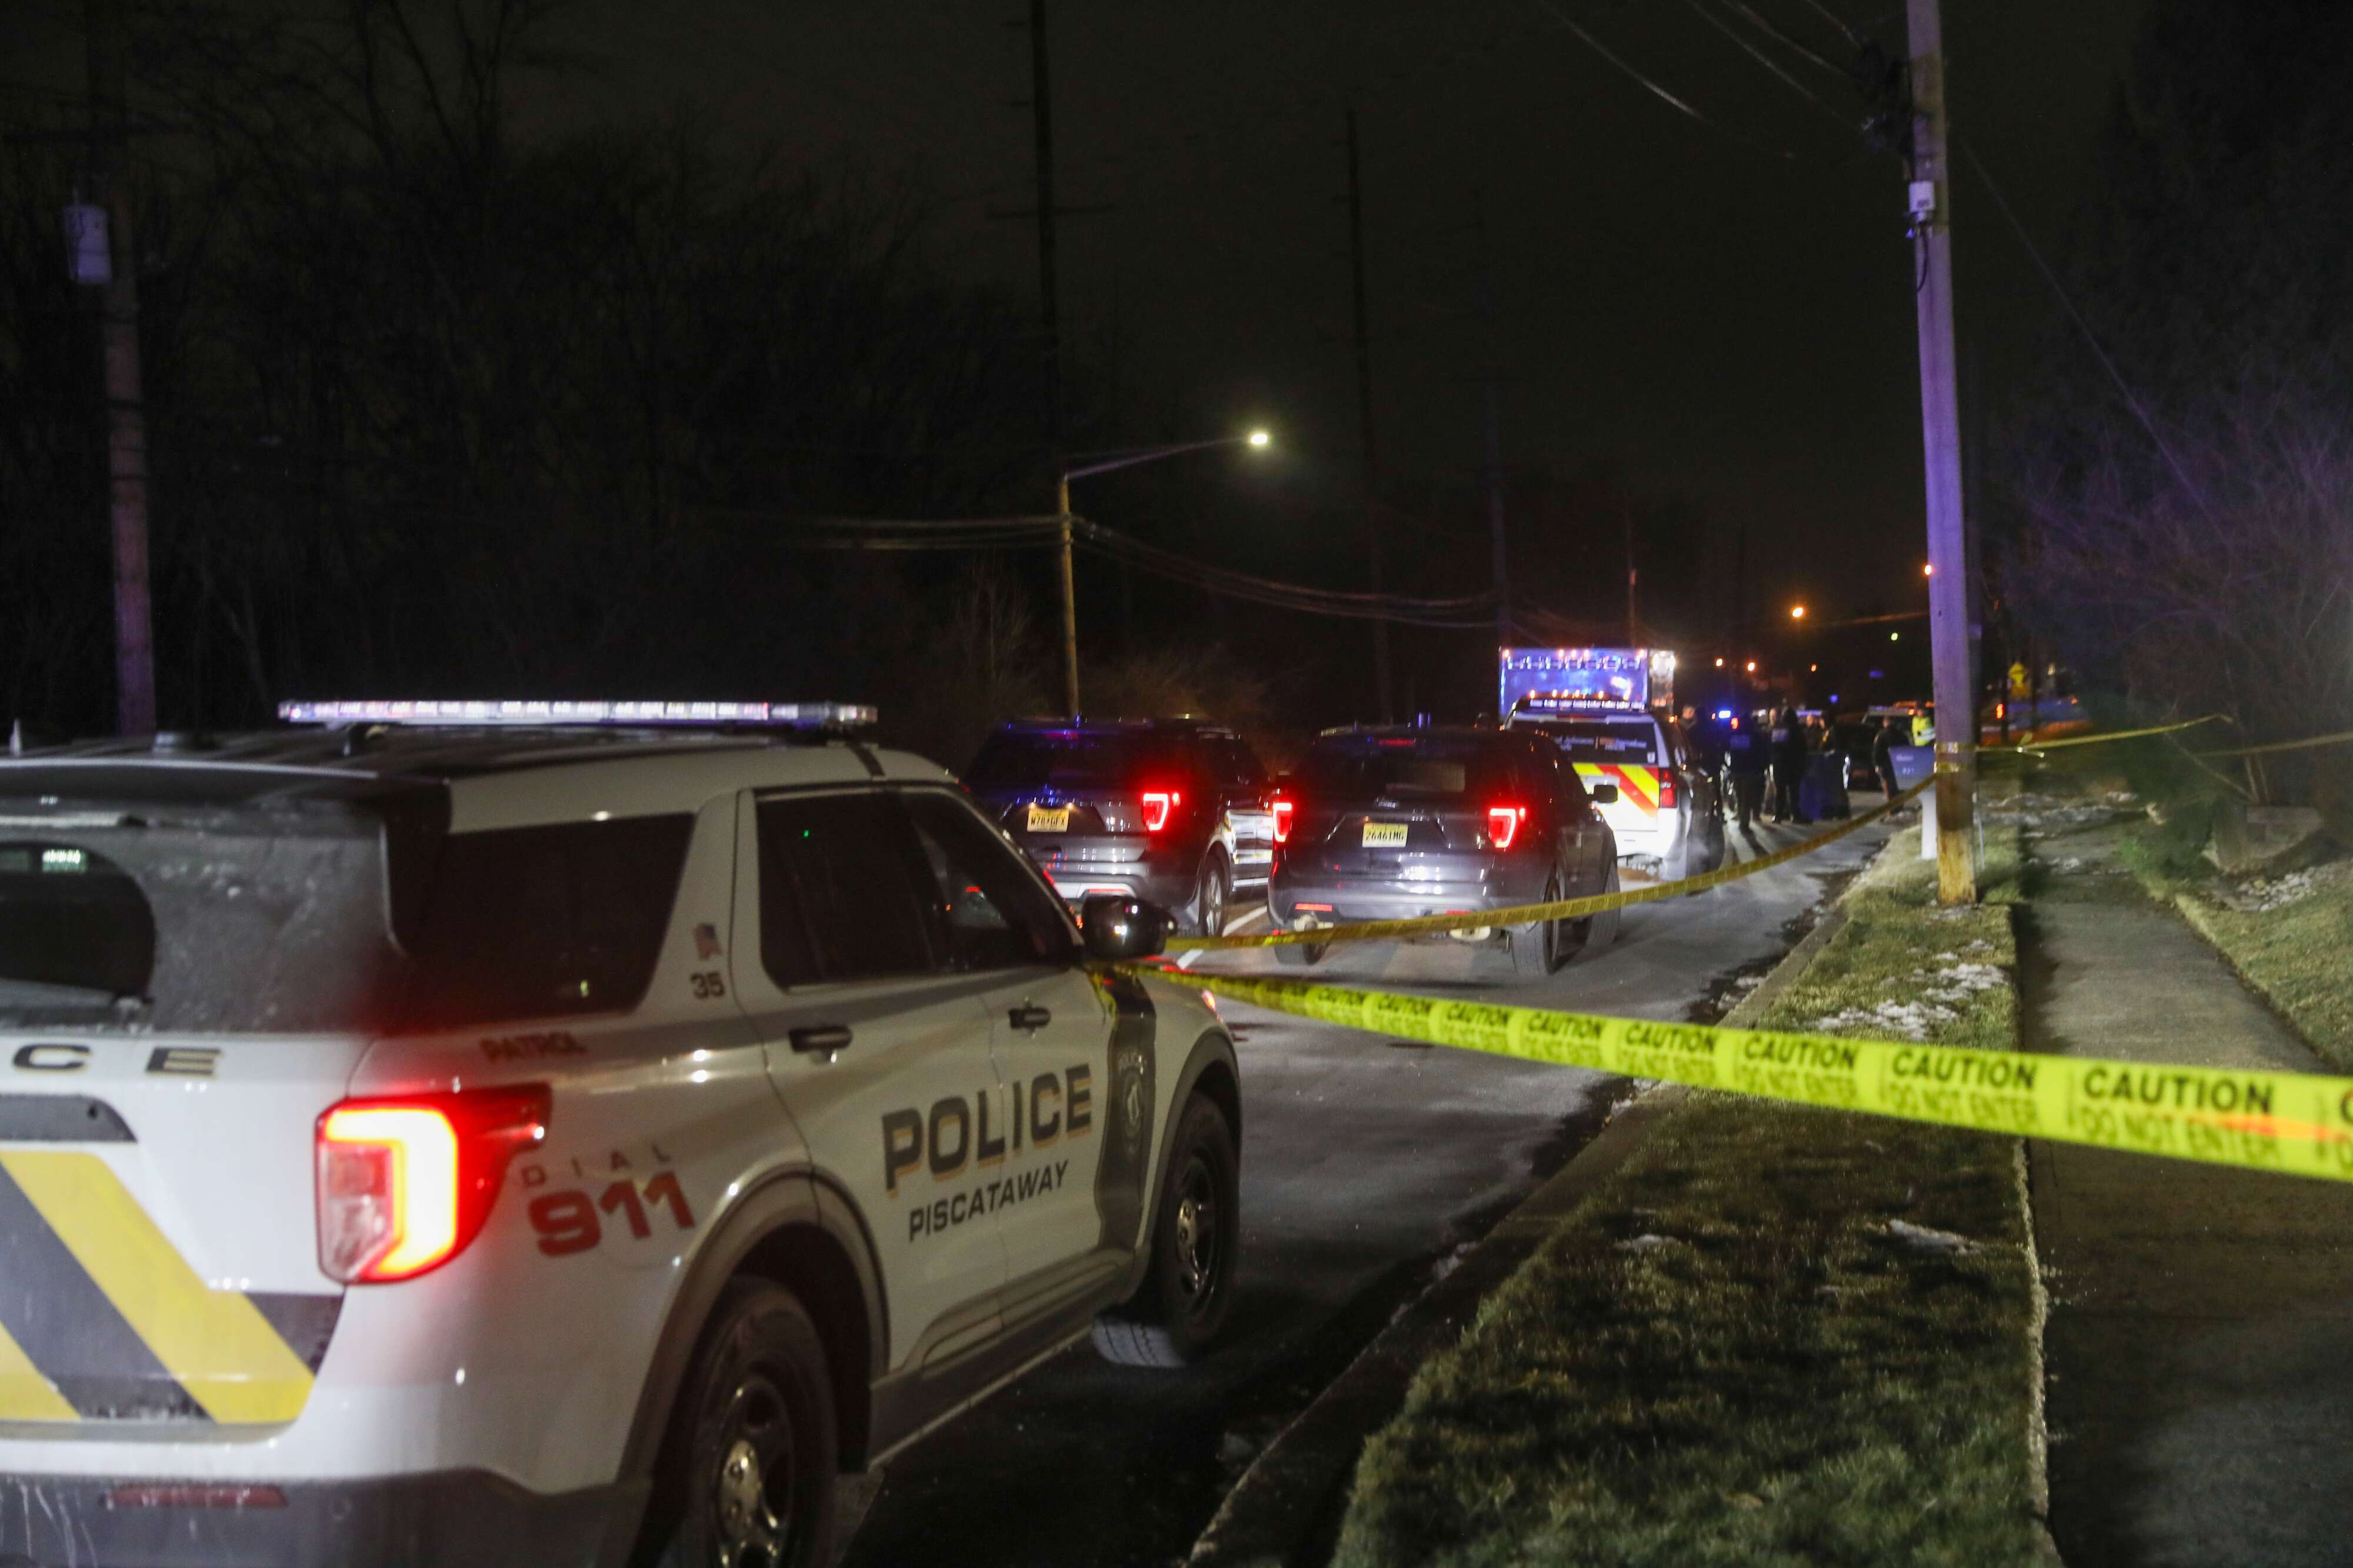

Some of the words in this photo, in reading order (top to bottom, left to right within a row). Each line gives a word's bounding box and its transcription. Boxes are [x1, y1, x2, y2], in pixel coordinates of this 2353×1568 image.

[690, 972, 725, 998] 35
[1447, 1002, 1512, 1027] CAUTION
[1528, 1011, 1604, 1040] CAUTION
[479, 1031, 587, 1065] PATROL
[1626, 1022, 1719, 1054] CAUTION
[1745, 1033, 1859, 1069] CAUTION
[1892, 1047, 2037, 1090] CAUTION
[2083, 1067, 2272, 1114] CAUTION
[882, 1063, 1092, 1194] POLICE
[521, 1145, 671, 1187] DIAL
[528, 1170, 695, 1257] 911
[909, 1159, 1068, 1242] PISCATAWAY
